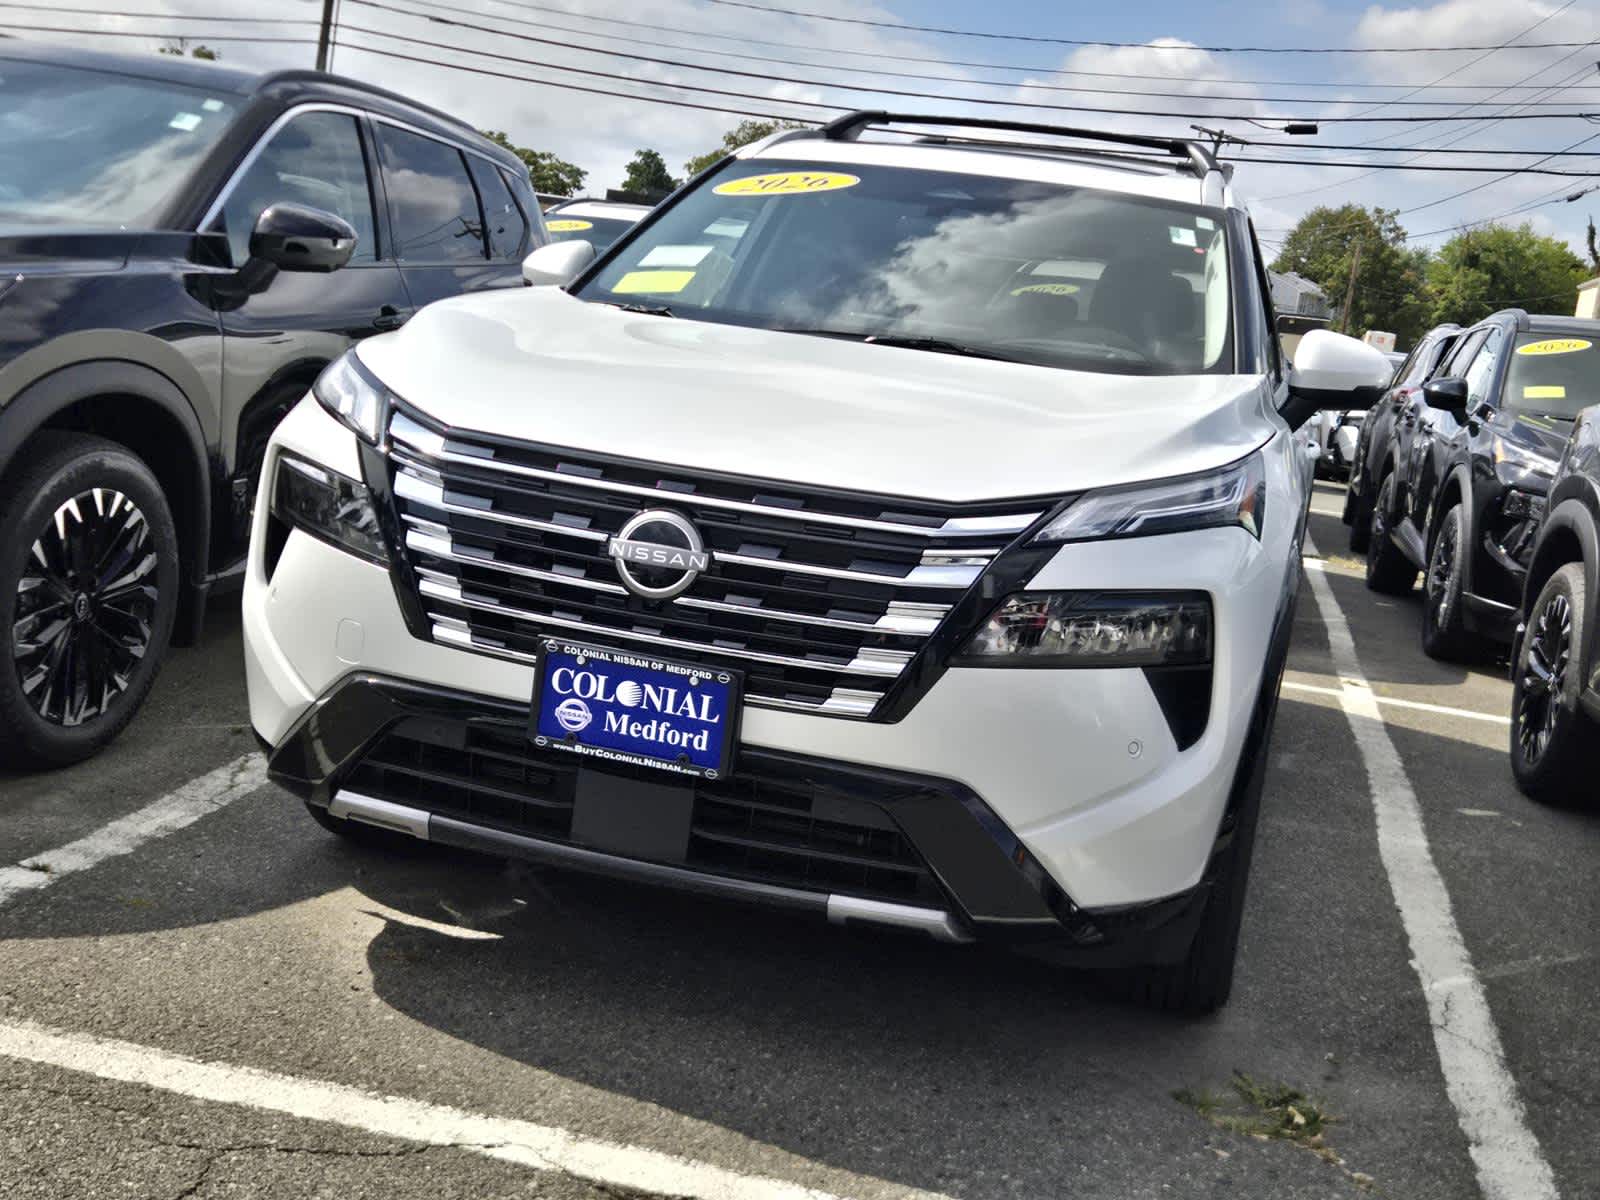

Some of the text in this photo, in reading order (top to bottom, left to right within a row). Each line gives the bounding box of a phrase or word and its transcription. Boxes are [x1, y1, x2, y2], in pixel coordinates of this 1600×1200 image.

[738, 175, 829, 192] 2026
[611, 541, 706, 569] NISSAN
[563, 645, 611, 661] COLONIAL
[613, 654, 649, 669] NISSAN
[651, 663, 664, 671] OF
[666, 665, 713, 680] MEDFORD
[551, 667, 720, 723] COLONIAL
[603, 711, 709, 751] Medford
